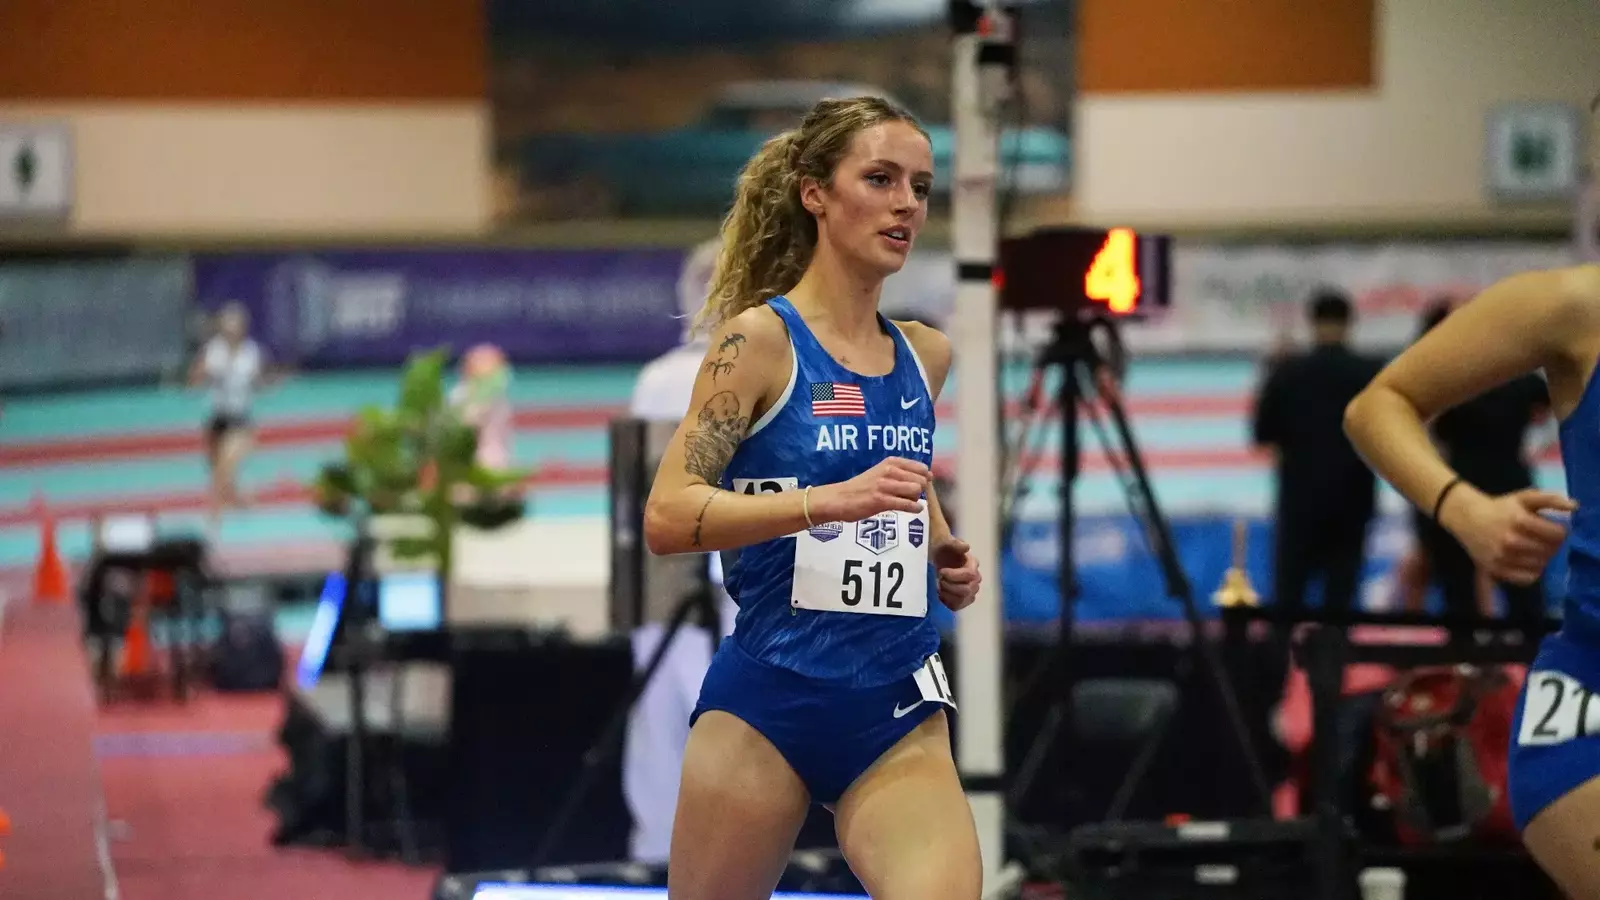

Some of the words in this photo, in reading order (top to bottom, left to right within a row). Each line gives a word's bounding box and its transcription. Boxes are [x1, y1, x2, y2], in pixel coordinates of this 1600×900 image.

[1085, 226, 1140, 314] 4
[816, 424, 858, 451] AIR
[867, 425, 931, 455] FORCE
[860, 519, 897, 541] 25
[841, 559, 904, 609] 512
[1532, 678, 1592, 738] 21
